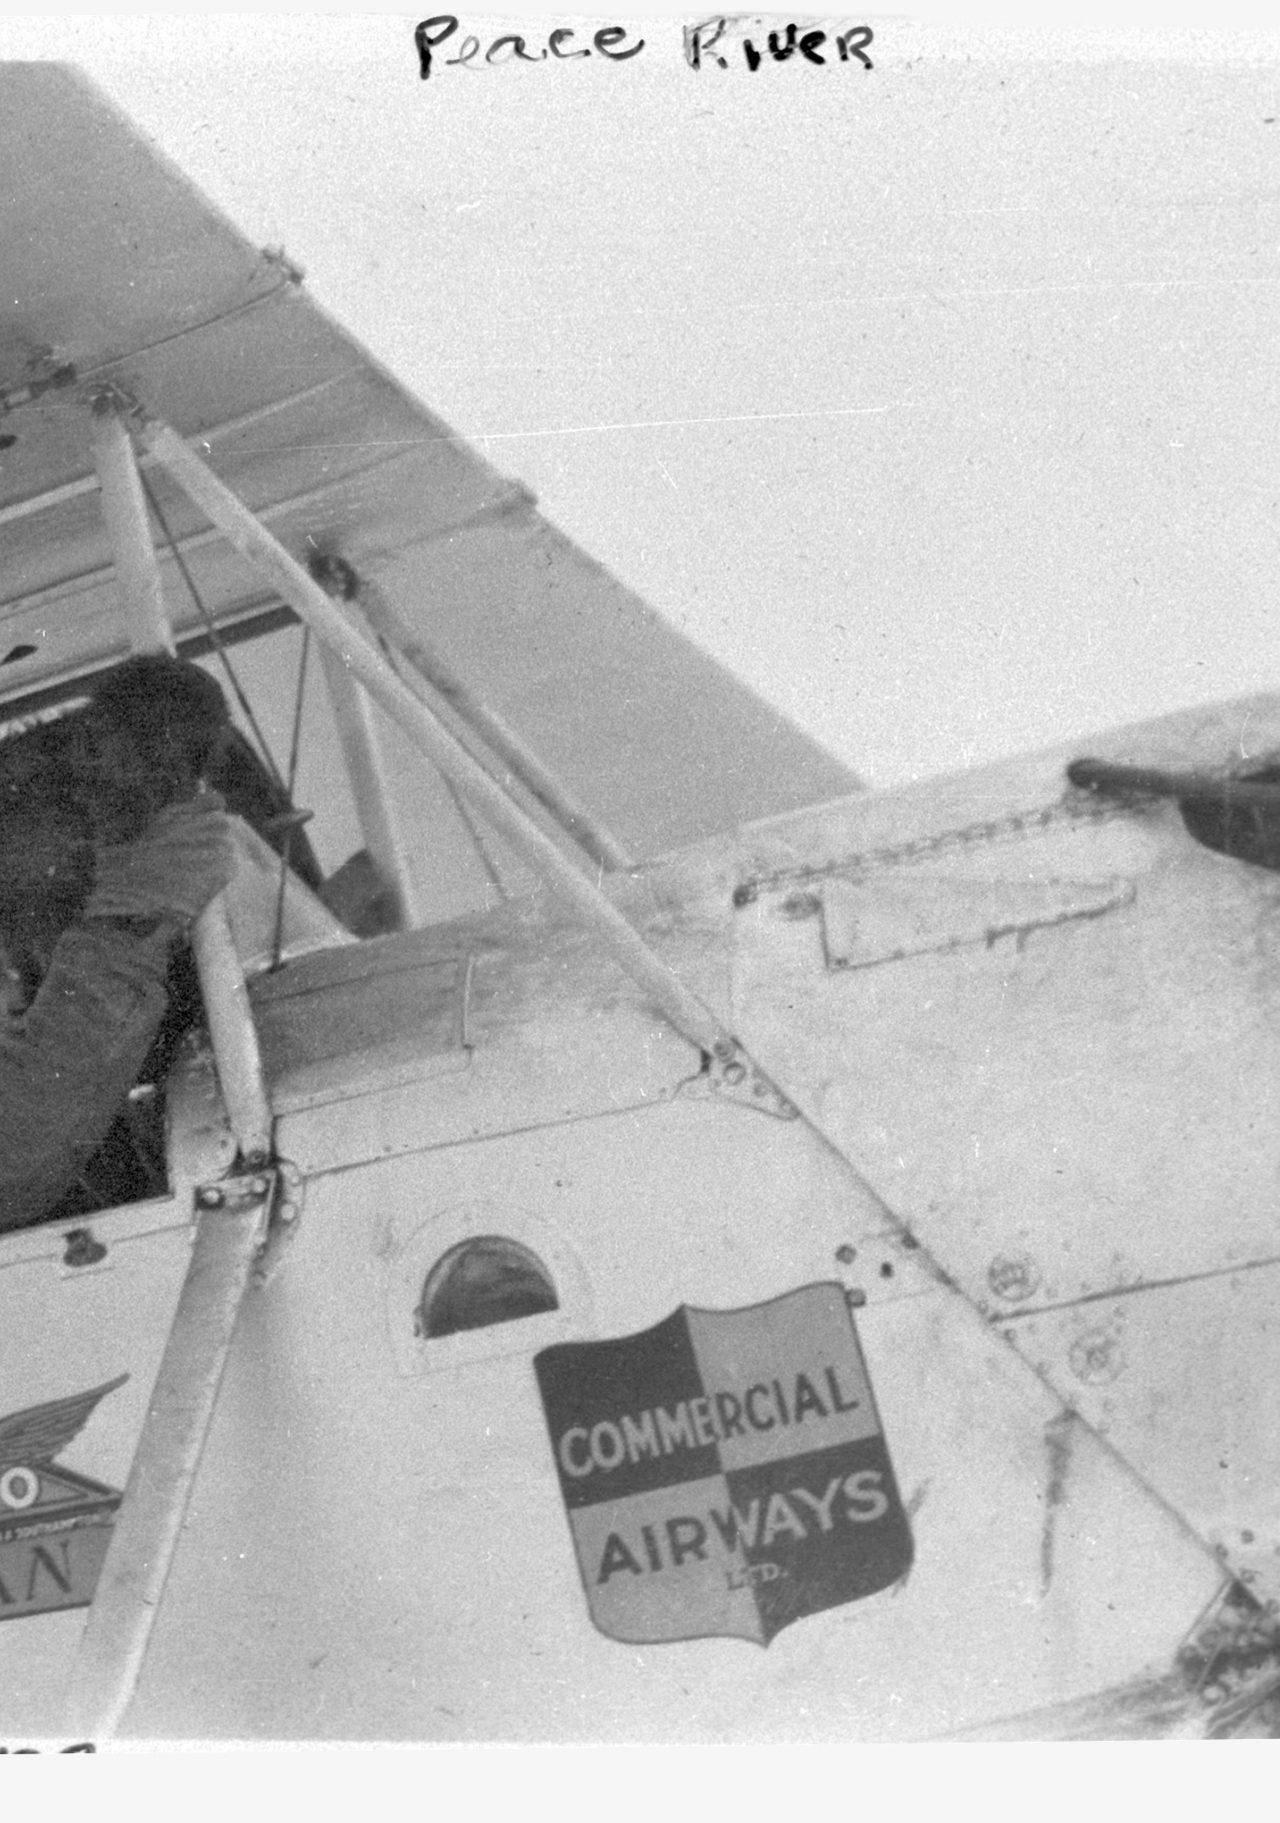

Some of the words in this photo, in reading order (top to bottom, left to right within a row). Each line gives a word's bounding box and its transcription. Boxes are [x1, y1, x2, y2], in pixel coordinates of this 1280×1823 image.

[414, 14, 646, 81] Peace
[559, 1366, 860, 1477] COMMERCIAL
[596, 1470, 890, 1586] AIRWAYS
